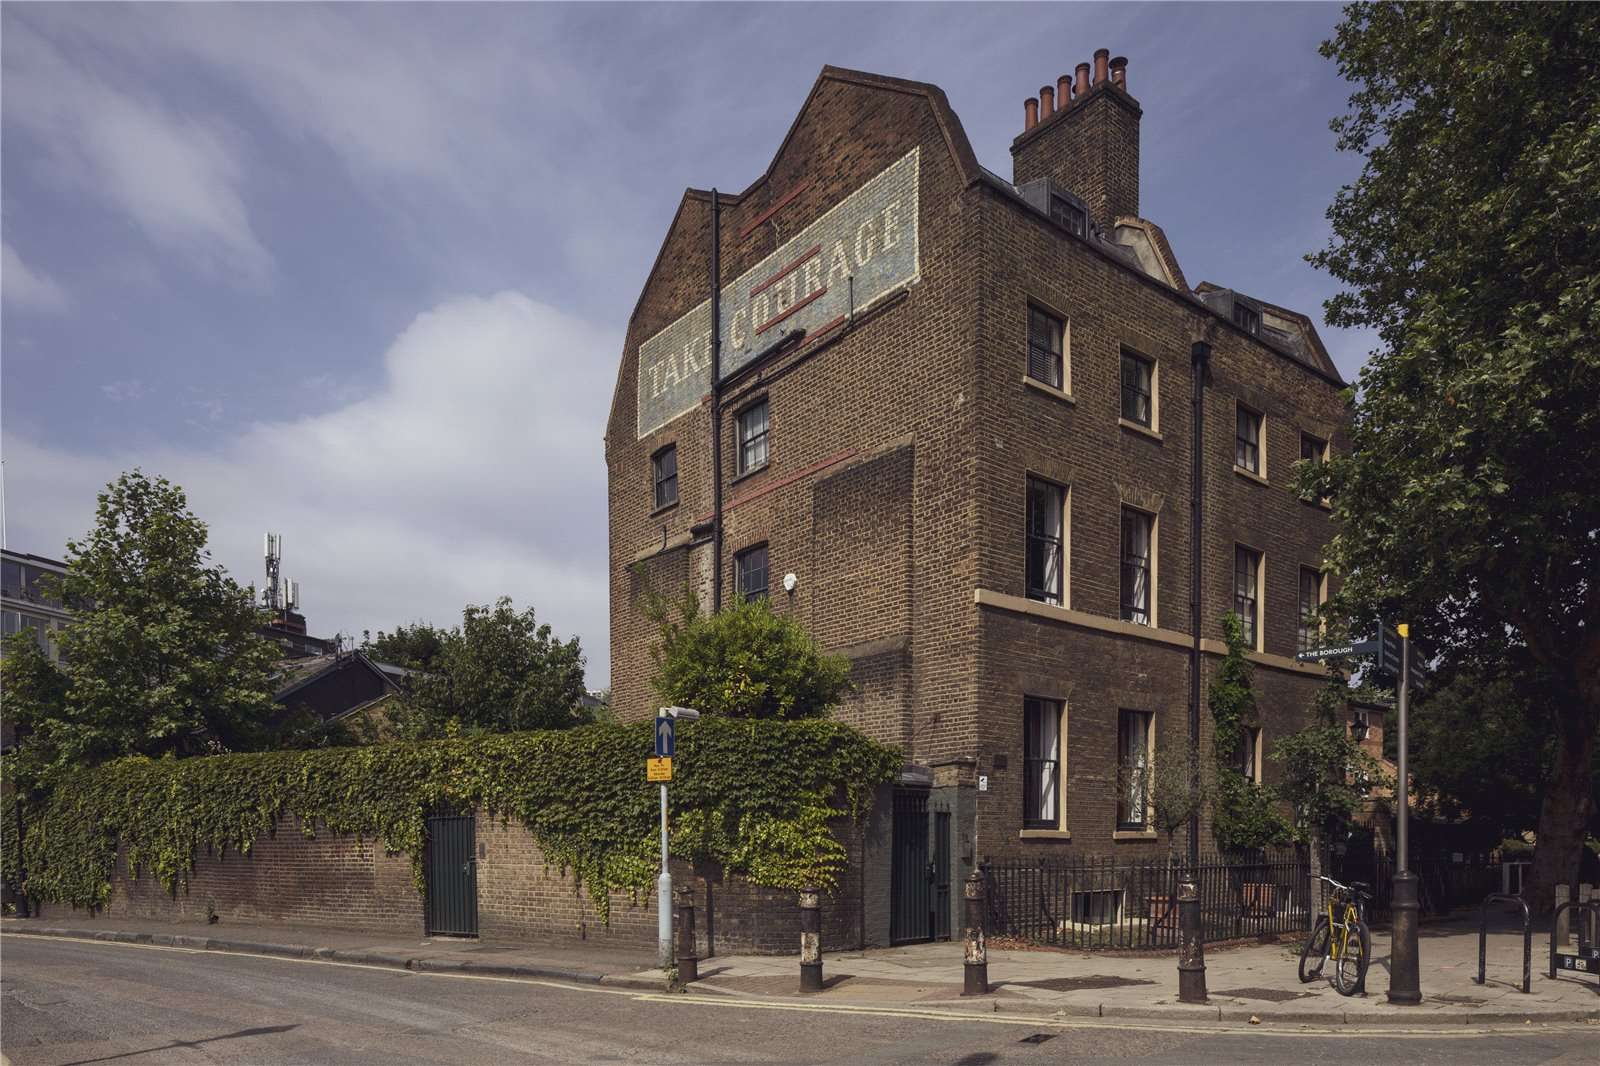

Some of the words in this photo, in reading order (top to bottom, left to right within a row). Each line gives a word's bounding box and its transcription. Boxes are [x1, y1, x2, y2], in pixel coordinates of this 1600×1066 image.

[730, 200, 900, 350] COURAGE
[1306, 650, 1319, 658] THE
[1319, 646, 1353, 656] BOROUGH
